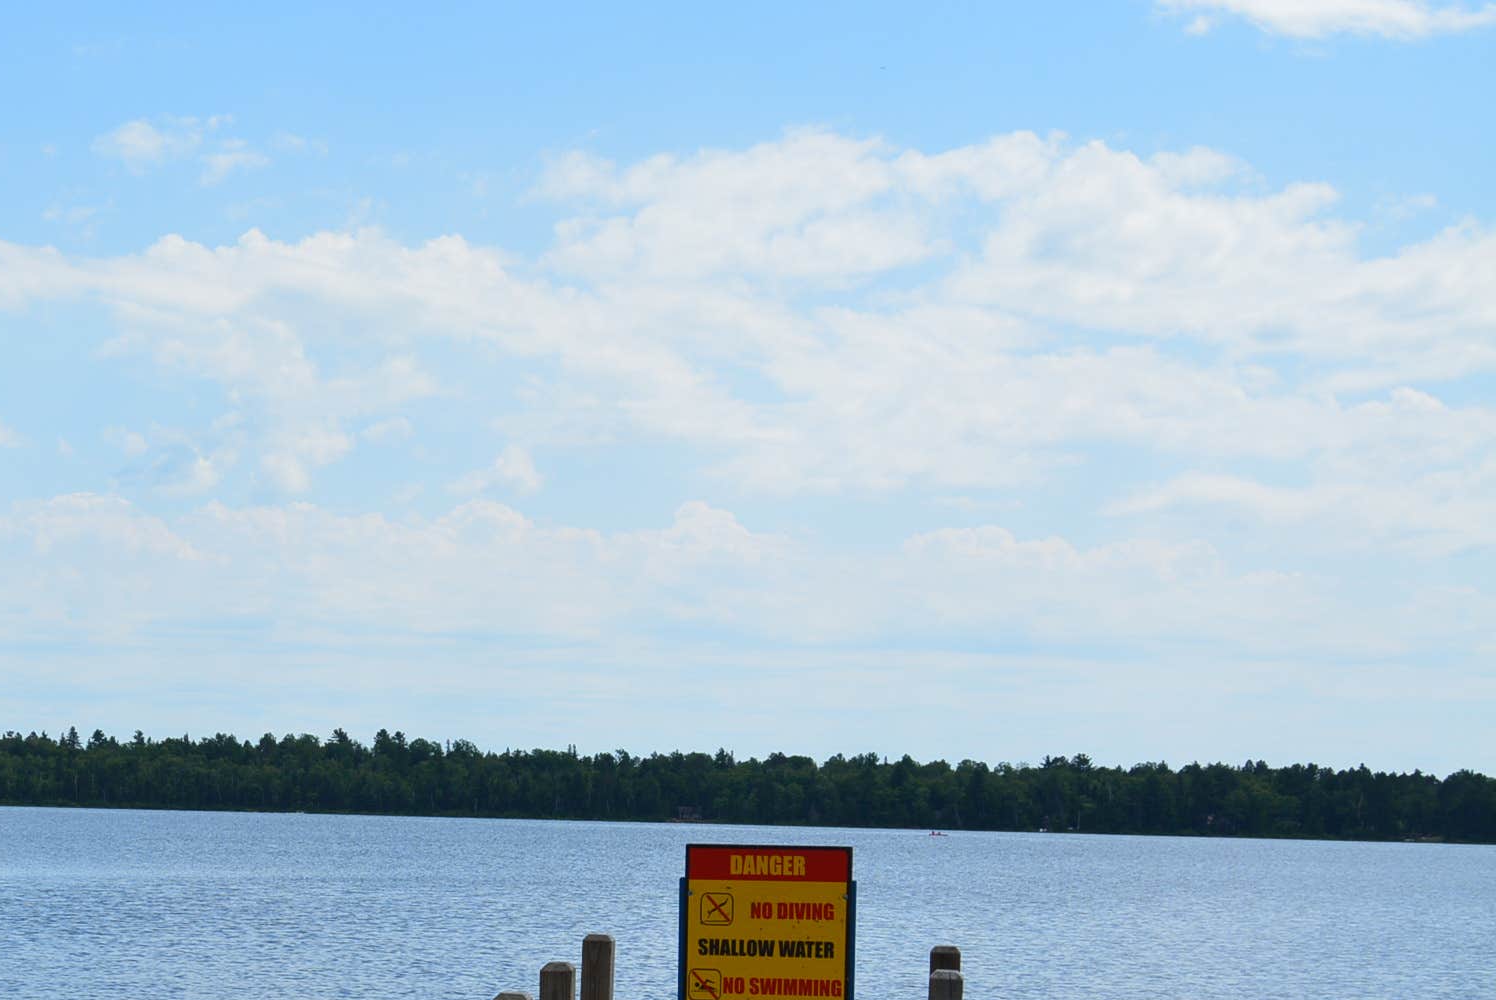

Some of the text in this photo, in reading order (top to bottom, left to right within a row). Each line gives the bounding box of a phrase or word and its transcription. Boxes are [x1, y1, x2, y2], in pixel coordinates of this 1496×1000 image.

[730, 855, 806, 876] DANGER
[750, 902, 835, 921] NO DIVING
[698, 938, 835, 959] SHALLOW WATER
[722, 977, 842, 997] NO SWIMMING
